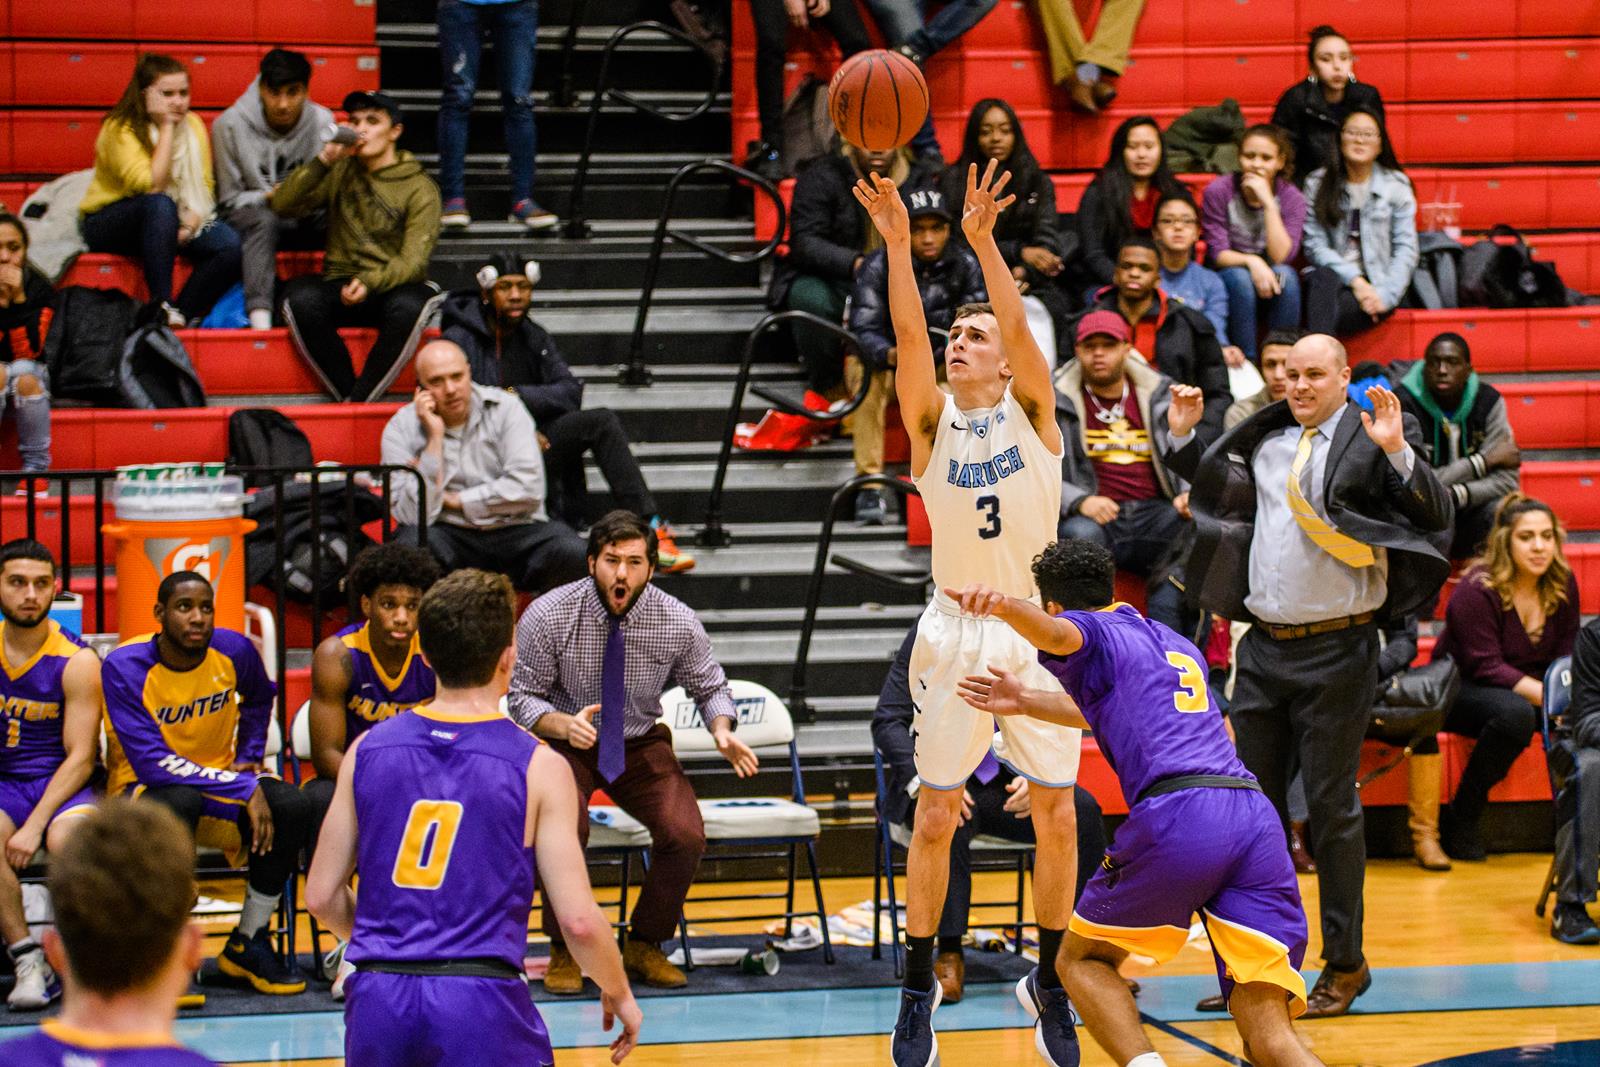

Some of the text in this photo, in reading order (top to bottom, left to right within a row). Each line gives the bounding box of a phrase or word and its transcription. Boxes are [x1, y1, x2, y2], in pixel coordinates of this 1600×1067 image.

[910, 190, 942, 209] NY
[947, 444, 1025, 488] BARUCH
[976, 494, 1002, 540] 3
[172, 544, 211, 582] G
[1165, 650, 1209, 713] 3
[6, 718, 21, 748] 1
[675, 697, 766, 729] BACH
[391, 799, 464, 890] 0
